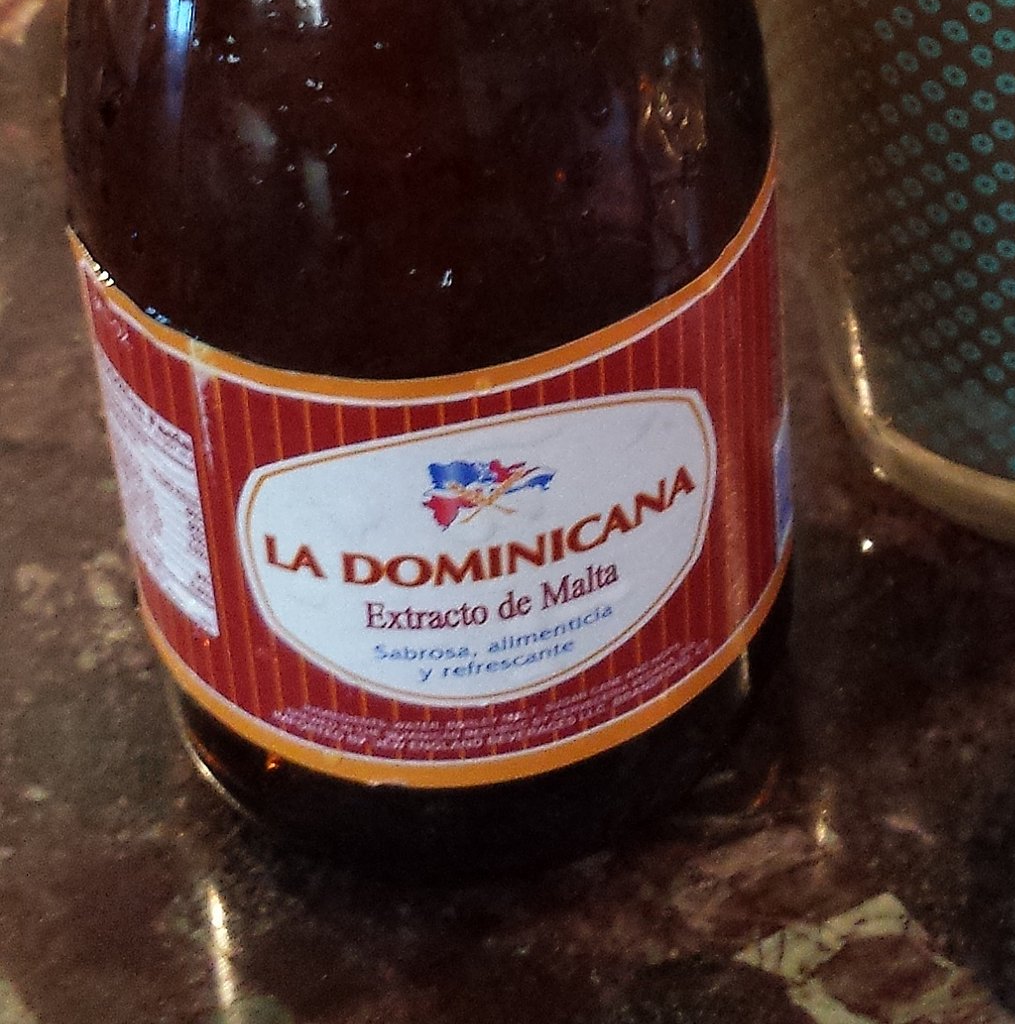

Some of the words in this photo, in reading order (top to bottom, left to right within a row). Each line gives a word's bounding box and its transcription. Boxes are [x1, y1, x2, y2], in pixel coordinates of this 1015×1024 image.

[265, 533, 326, 580] LA
[341, 465, 696, 588] DOMINICANA
[366, 601, 489, 630] Extracto
[499, 590, 533, 620] de
[540, 563, 620, 611] Malta
[374, 643, 478, 662] Sabrosa,
[488, 604, 613, 654] alimenticia
[419, 667, 433, 682] y
[442, 640, 575, 677] refrescante
